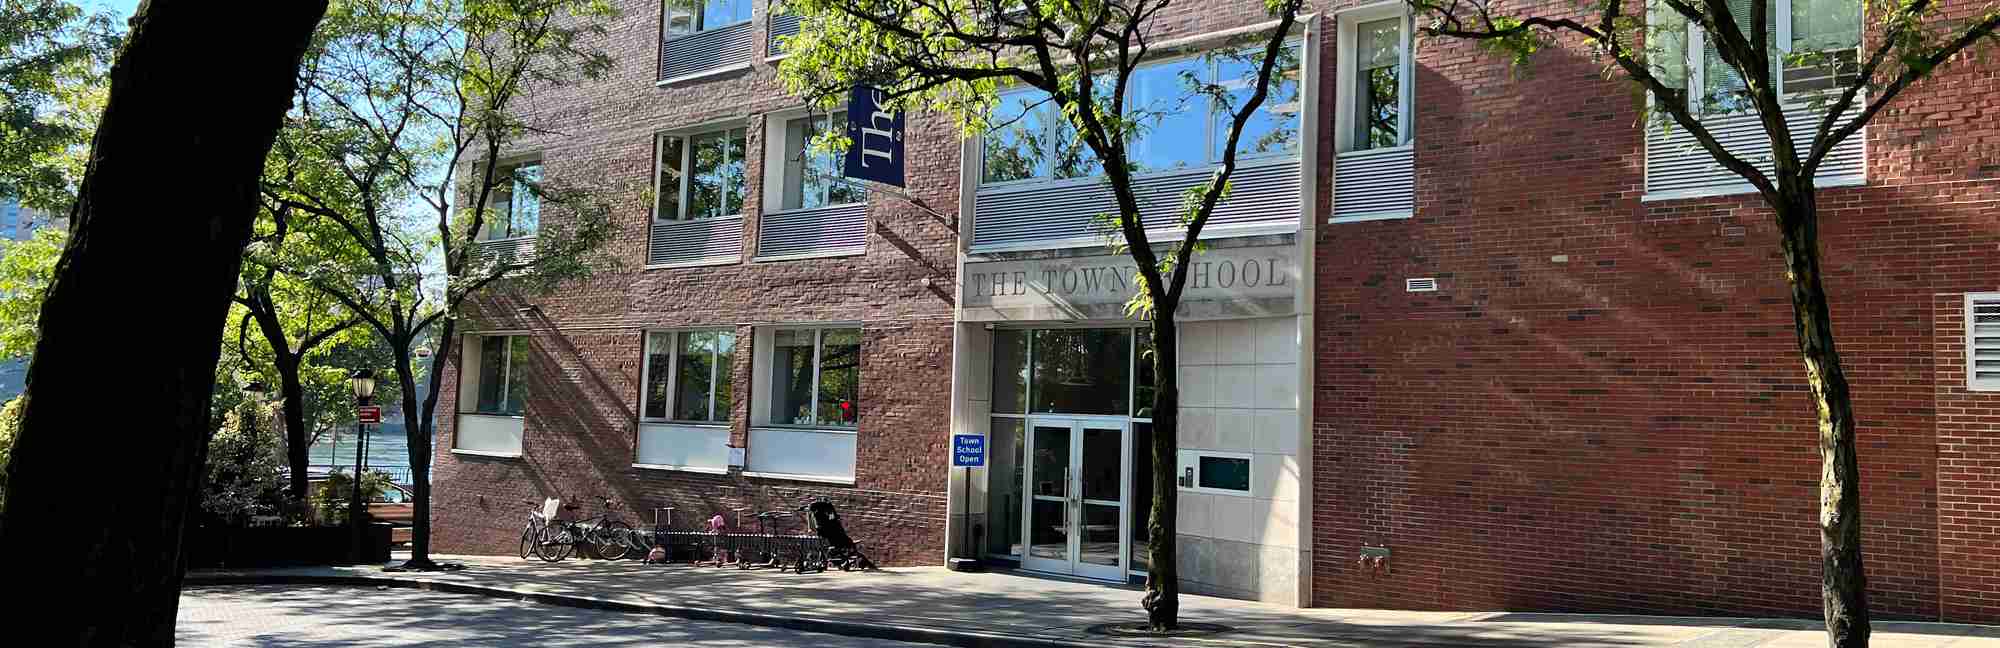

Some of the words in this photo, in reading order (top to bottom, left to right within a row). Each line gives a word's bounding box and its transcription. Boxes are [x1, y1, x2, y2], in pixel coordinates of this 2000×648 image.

[972, 271, 1026, 297] THE
[1042, 265, 1132, 296] TOWN
[1161, 258, 1287, 289] HOOL
[960, 437, 980, 445] Town
[957, 446, 982, 454] School
[960, 455, 979, 464] Open
